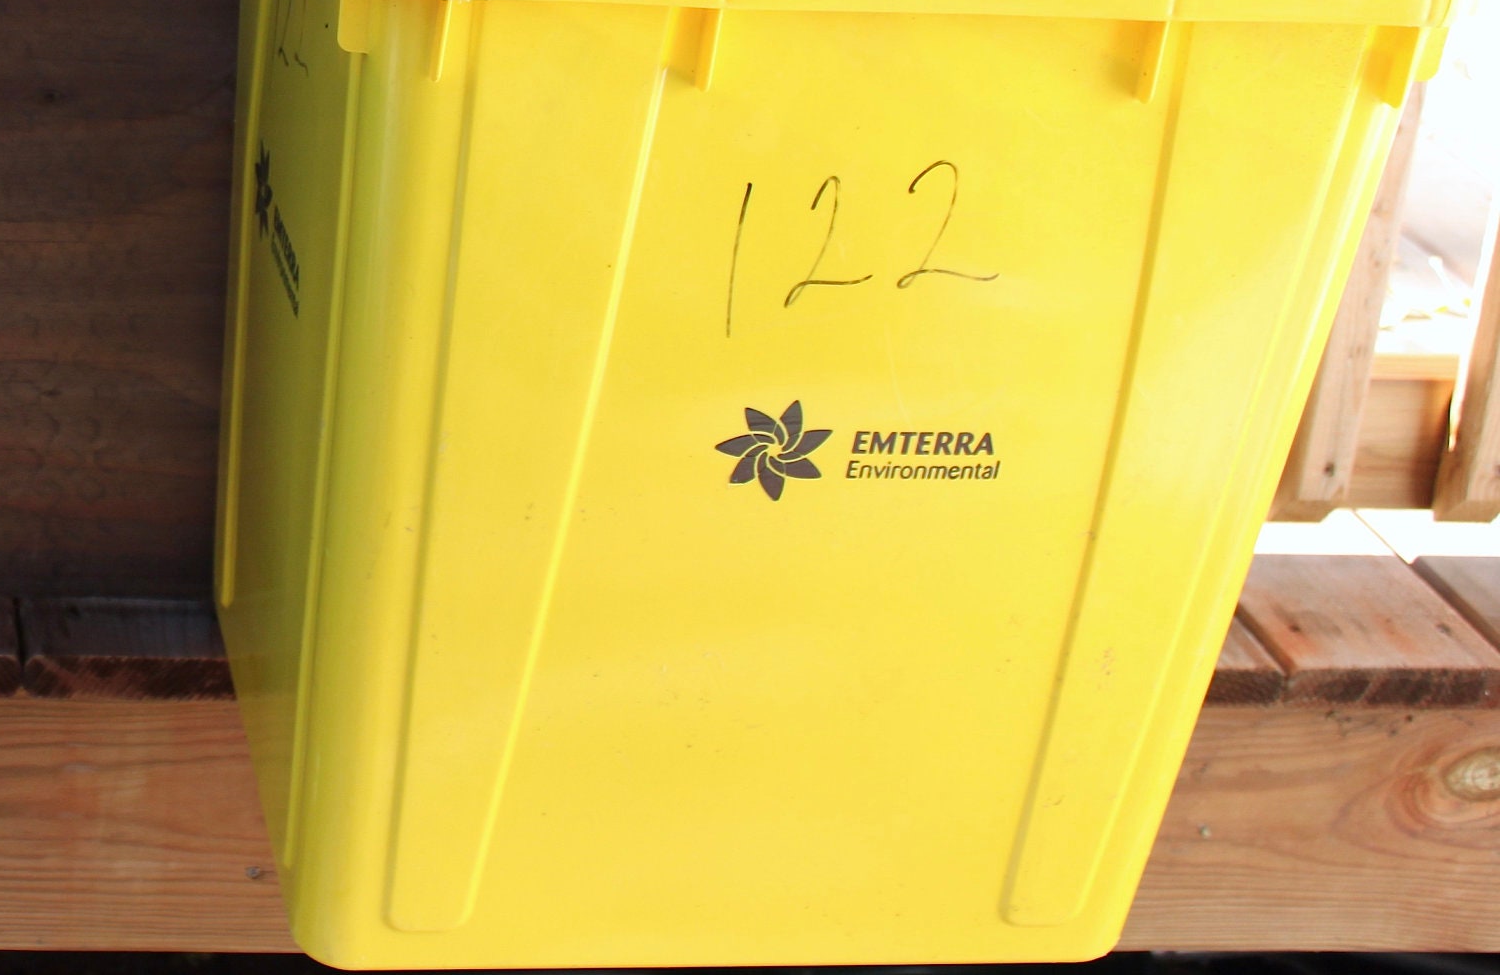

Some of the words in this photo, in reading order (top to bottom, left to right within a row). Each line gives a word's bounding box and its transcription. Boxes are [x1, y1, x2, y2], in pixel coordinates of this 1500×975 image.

[726, 159, 1000, 339] 122
[851, 430, 995, 456] EMTERRA
[845, 460, 1001, 480] Environmental
